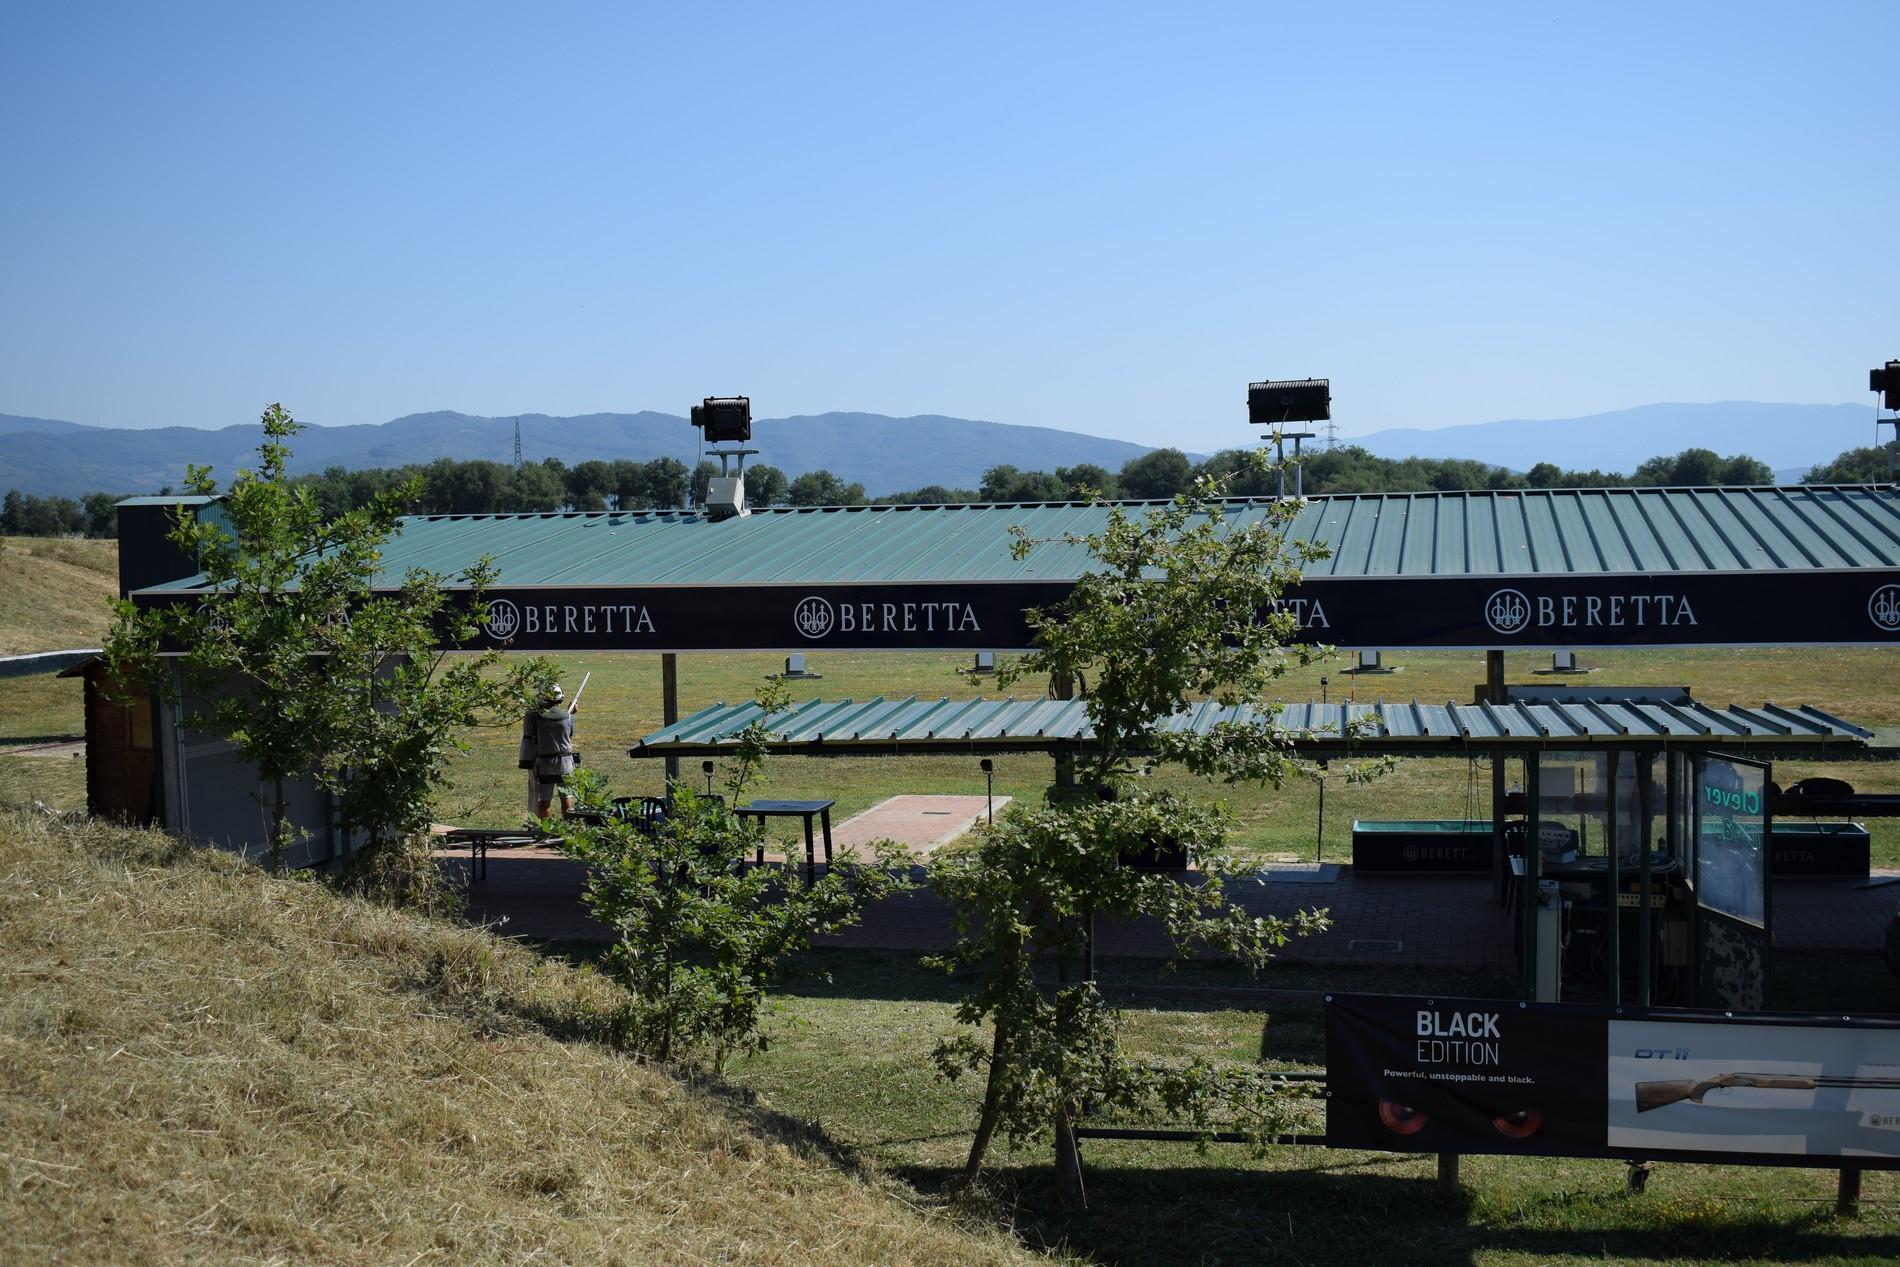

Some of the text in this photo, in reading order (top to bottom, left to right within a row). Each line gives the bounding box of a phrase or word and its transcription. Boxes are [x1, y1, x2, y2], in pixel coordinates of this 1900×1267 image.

[525, 605, 656, 633] BERETTA
[840, 603, 981, 632] BERETTA
[1537, 595, 1698, 626] BERETTA
[1421, 847, 1471, 860] BERETT
[1417, 1010, 1501, 1038] BLACK
[1417, 1039, 1499, 1065] EDITION
[1384, 1069, 1535, 1085] Powerful, unstoppable and black.
